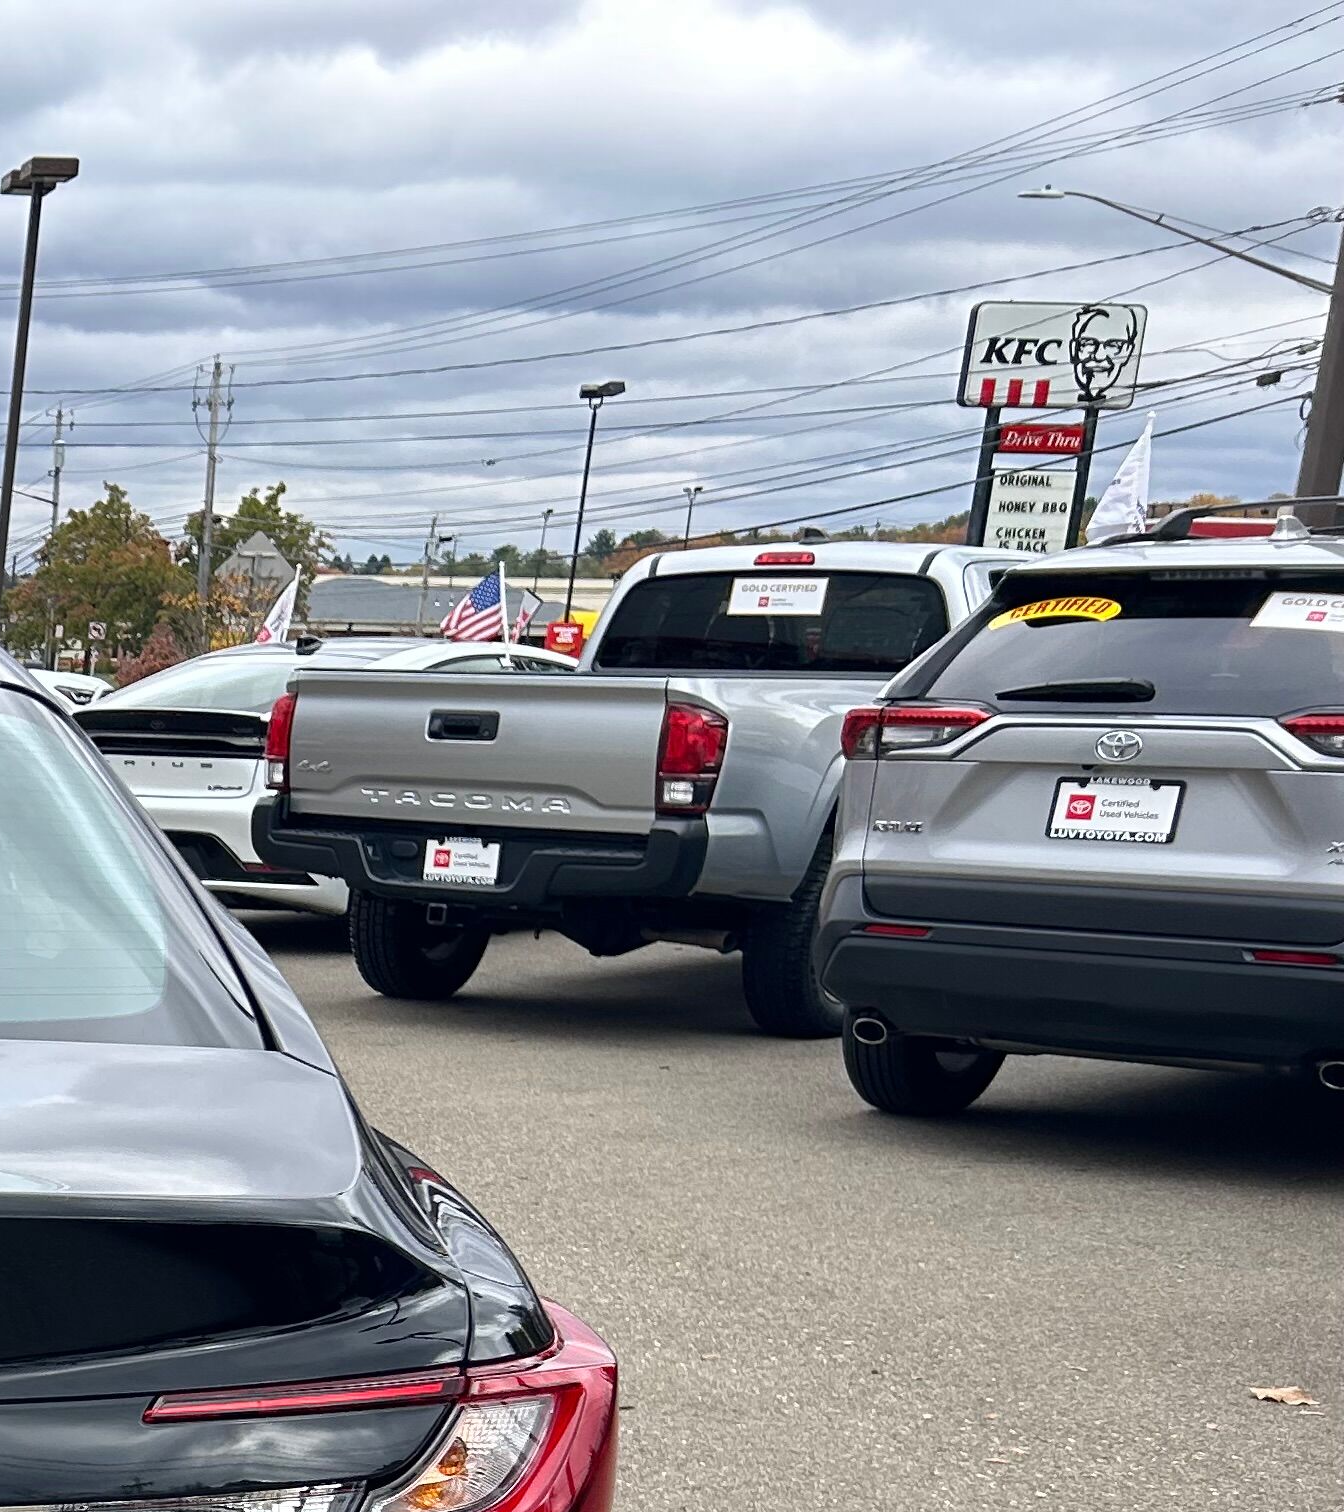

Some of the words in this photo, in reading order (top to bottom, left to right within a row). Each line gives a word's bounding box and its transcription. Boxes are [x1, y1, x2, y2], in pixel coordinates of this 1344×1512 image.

[980, 337, 1062, 365] KFC
[1004, 430, 1043, 447] Drive
[1047, 432, 1082, 449] Thru
[999, 474, 1052, 487] ORIGINAL
[998, 501, 1036, 513] HONEY
[1042, 502, 1068, 513] BBQ
[996, 527, 1046, 539] CHICKEN
[998, 541, 1010, 550] IS
[1016, 541, 1048, 552] BACK
[741, 583, 768, 593] GOLD
[769, 583, 818, 593] CERTIFIED
[1281, 597, 1328, 607] GOLD
[1010, 597, 1113, 620] CERTIFIED
[123, 760, 213, 769] RIUS
[1089, 776, 1151, 785] LAKEWOOD
[361, 788, 571, 814] TACOMA
[1101, 799, 1140, 808] Certified
[1099, 810, 1122, 819] Used
[1123, 811, 1160, 820] Vehicles
[1049, 827, 1168, 843] LUVTOYOTA.COM
